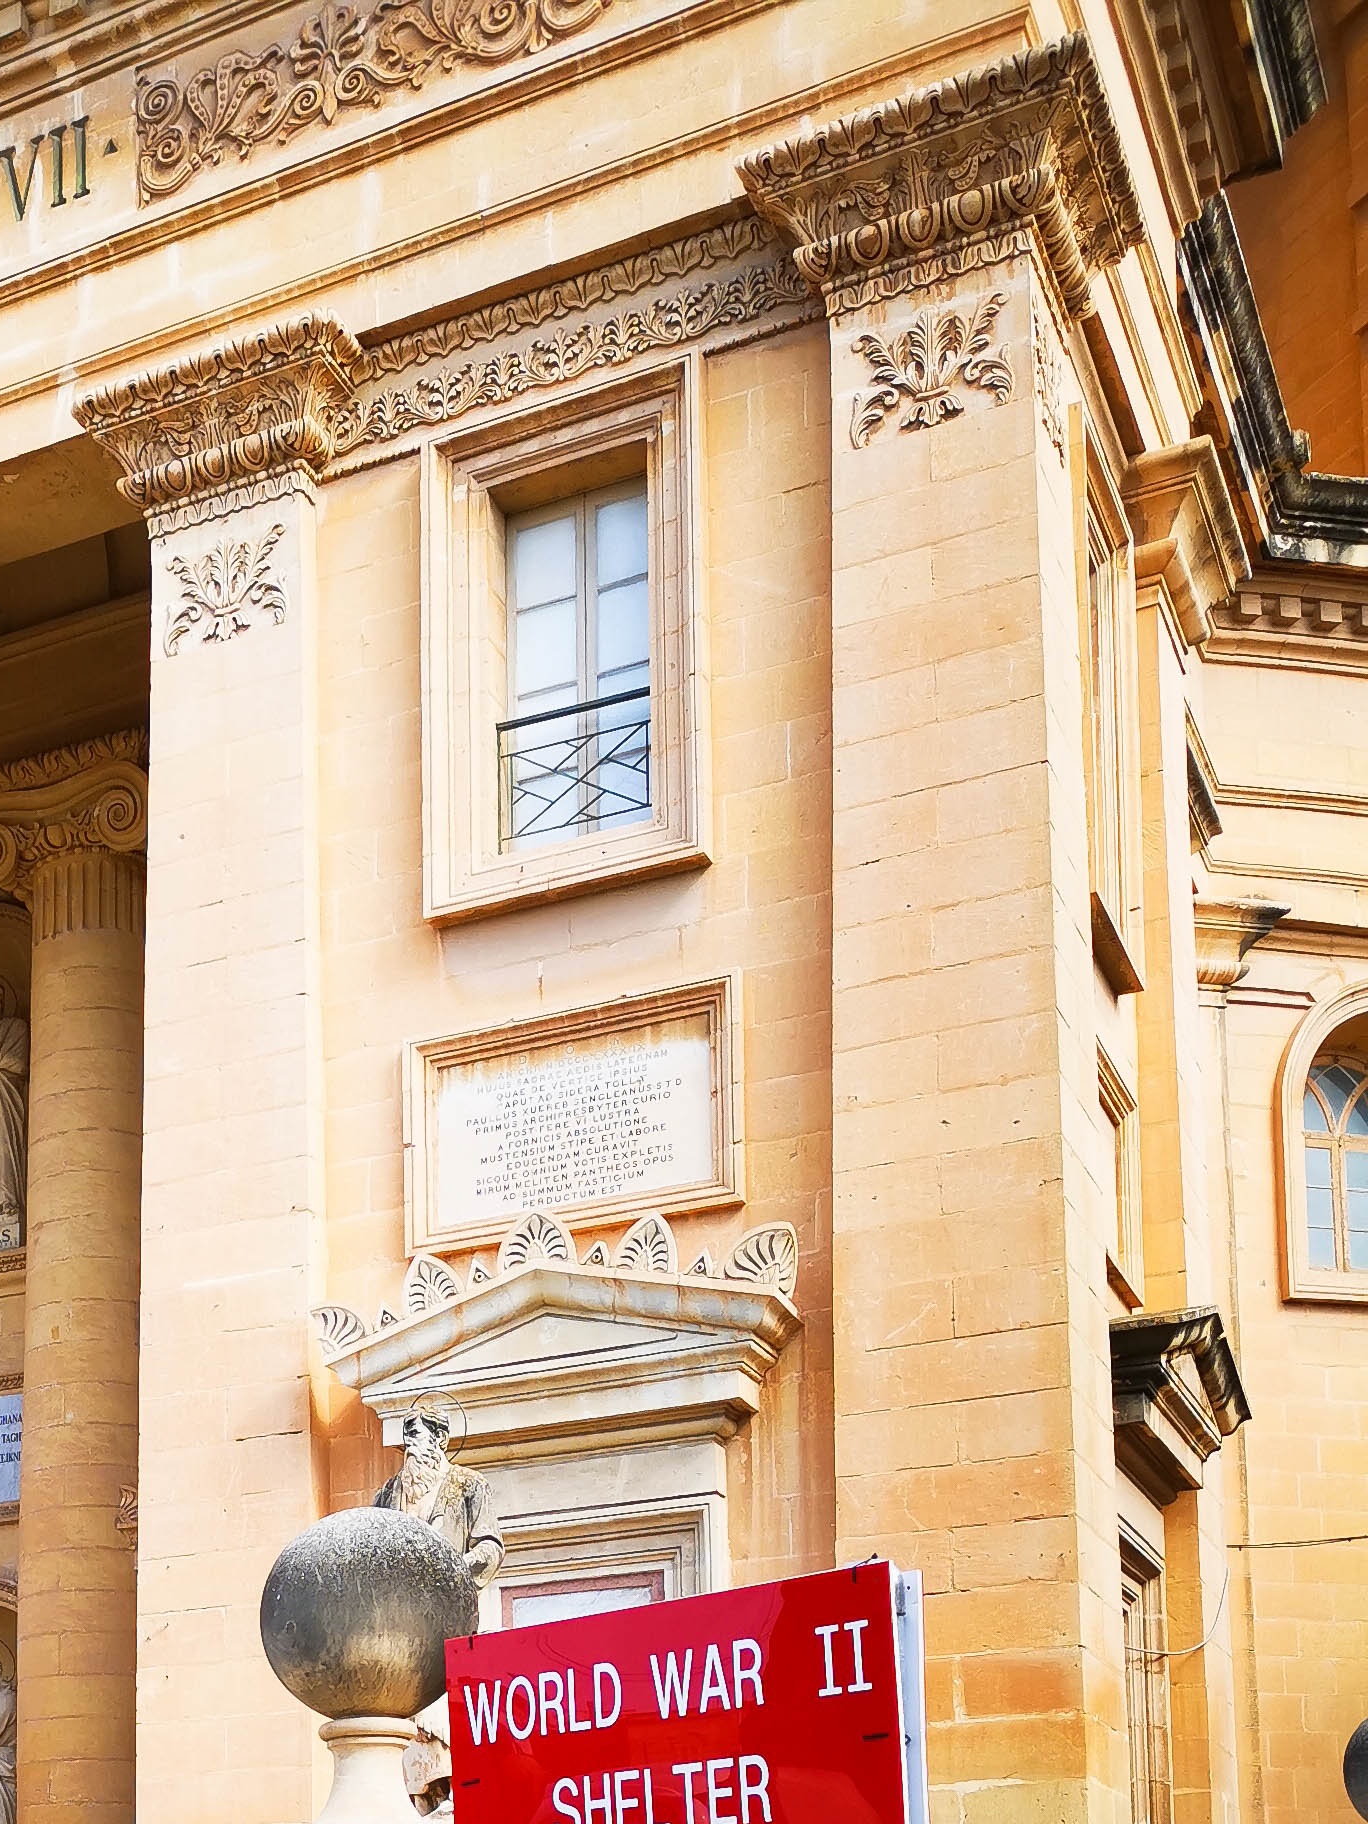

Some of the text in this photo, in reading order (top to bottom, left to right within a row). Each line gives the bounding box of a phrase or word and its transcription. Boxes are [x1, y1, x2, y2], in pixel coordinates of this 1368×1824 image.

[566, 1116, 648, 1138] ABSOLUTIONE
[586, 1139, 639, 1156] CURAVIT
[643, 1154, 674, 1166] OPUS
[464, 1619, 873, 1747] WORLD WAR II
